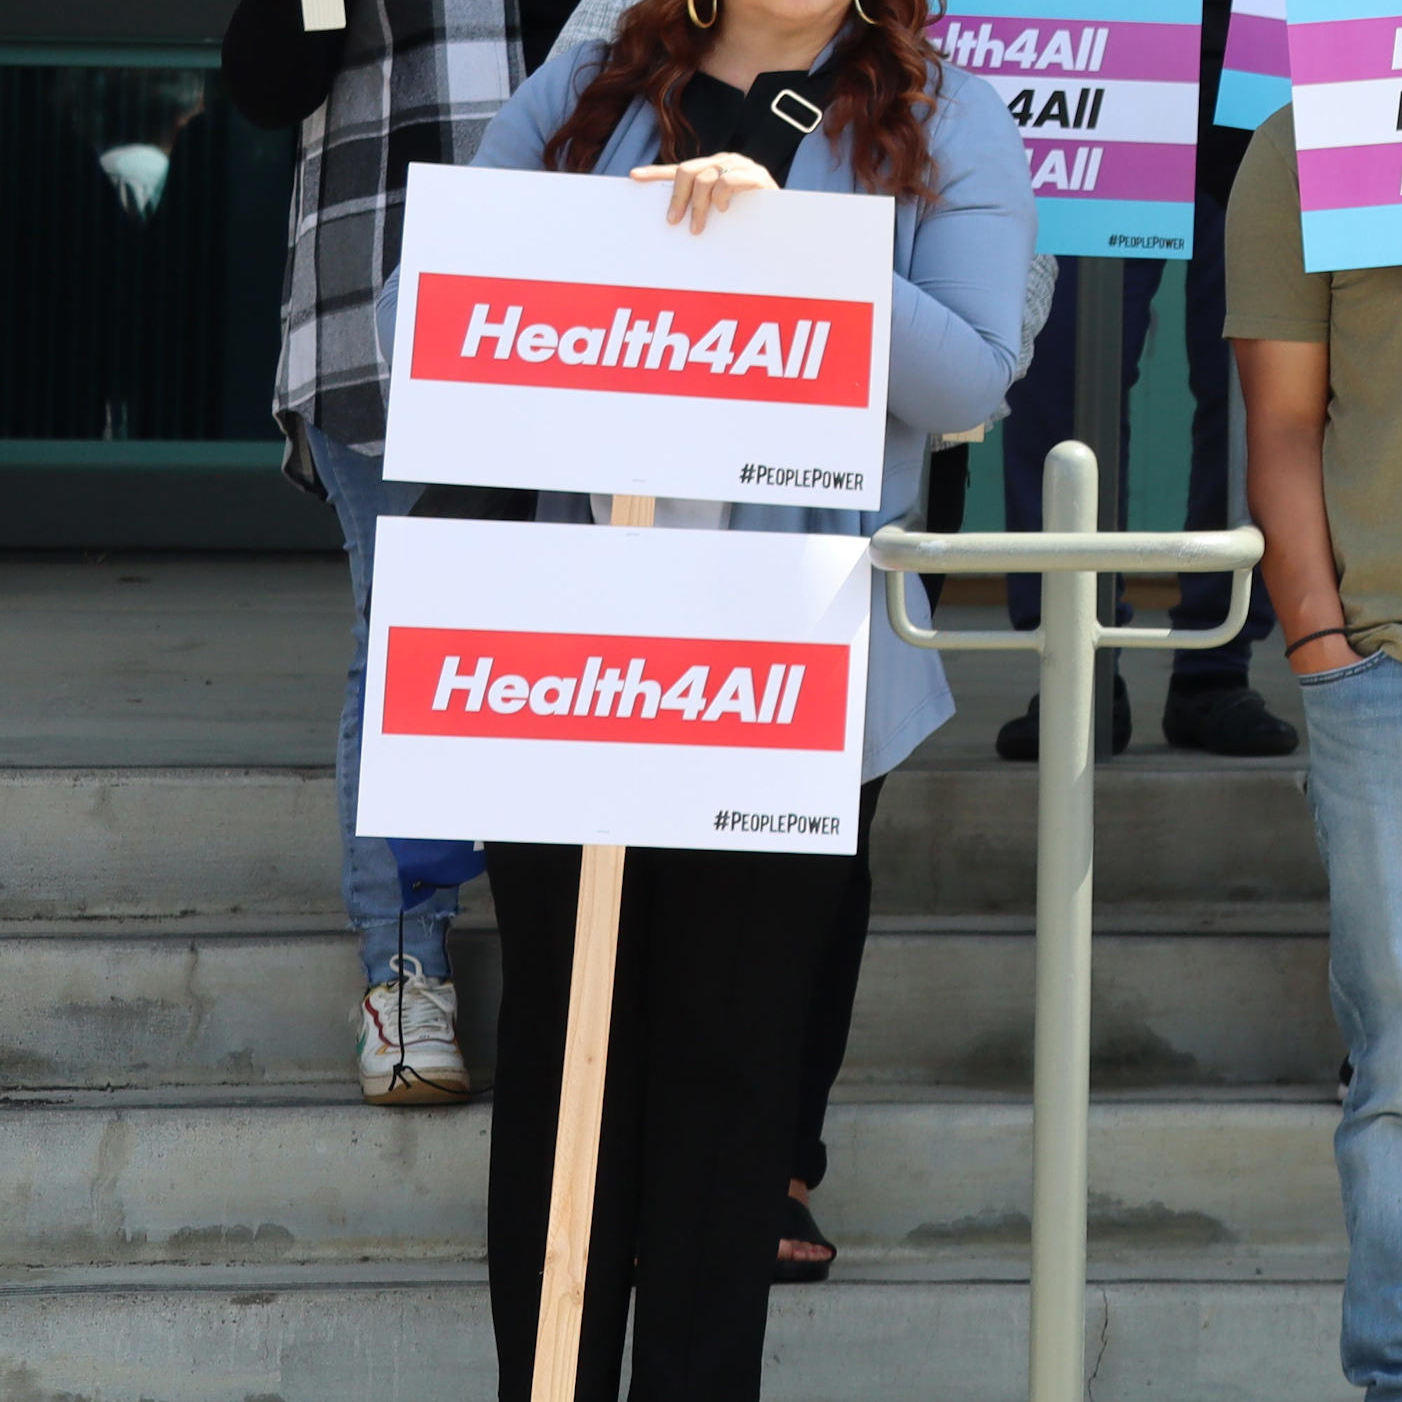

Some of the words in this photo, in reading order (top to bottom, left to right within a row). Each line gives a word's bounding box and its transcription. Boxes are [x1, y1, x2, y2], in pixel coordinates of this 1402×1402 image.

[1107, 233, 1186, 251] #PEOPLEPOWER
[459, 302, 832, 381] Health4All
[739, 463, 865, 492] #PEOPLEPOWER
[431, 655, 806, 725] Health4All
[713, 809, 841, 836] #PEOPLEPOWER
